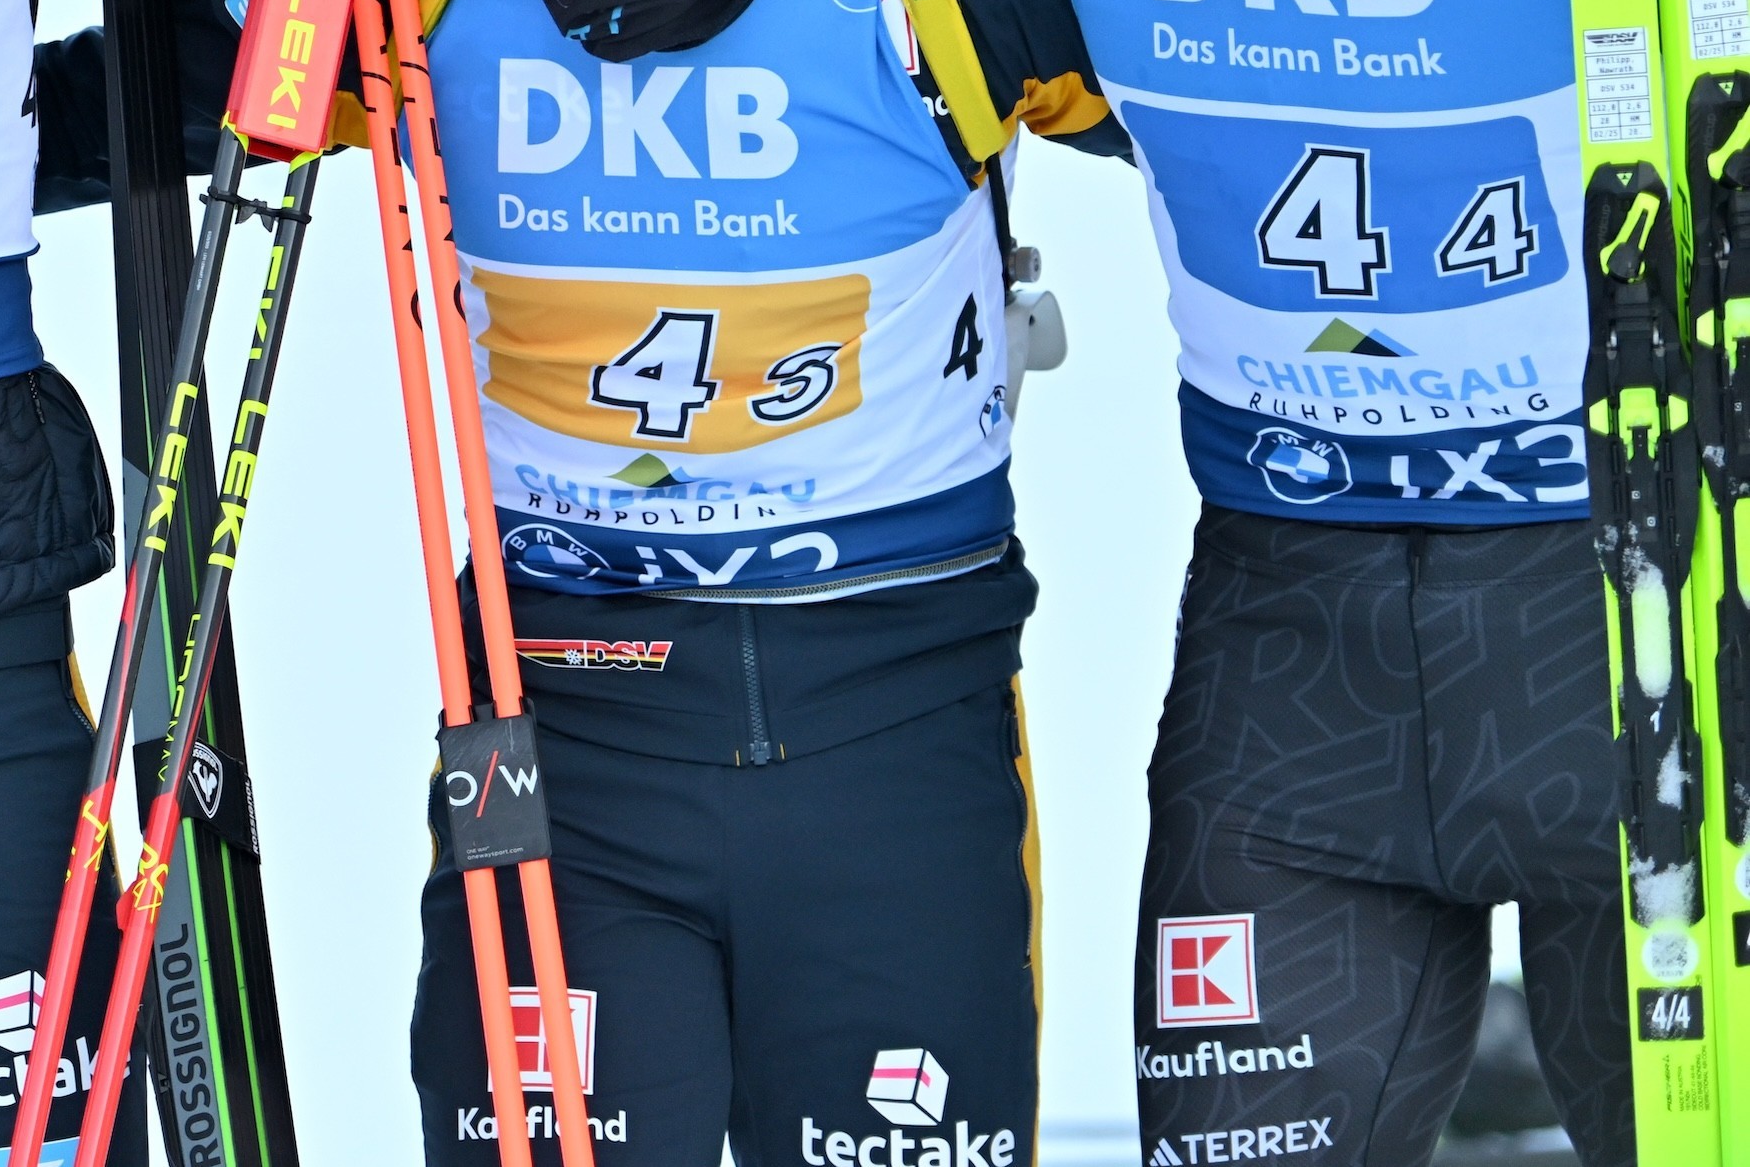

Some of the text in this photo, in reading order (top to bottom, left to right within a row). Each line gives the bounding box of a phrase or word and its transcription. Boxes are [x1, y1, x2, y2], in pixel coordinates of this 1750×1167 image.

[1152, 20, 1448, 78] Das kann Bank
[497, 56, 800, 181] DKB
[498, 193, 801, 237] Das kann Bank
[1253, 142, 1393, 301] 4
[1433, 174, 1541, 289] 4
[942, 291, 985, 383] 4
[587, 306, 723, 443] 4
[1236, 353, 1540, 401] CHIEMGAU
[143, 381, 198, 554] LEKI
[207, 399, 269, 571] LEKI
[528, 492, 777, 526] RUHPOLDIN
[509, 529, 589, 558] BMW
[590, 640, 671, 672] DSV
[1651, 994, 1691, 1031] 4/4
[159, 923, 222, 1167] ROSSIGNOL
[1136, 1034, 1315, 1080] Kaufland
[457, 1105, 627, 1143] Kaflnd
[800, 1118, 1016, 1167] tectake
[1181, 1117, 1333, 1165] TERREX
